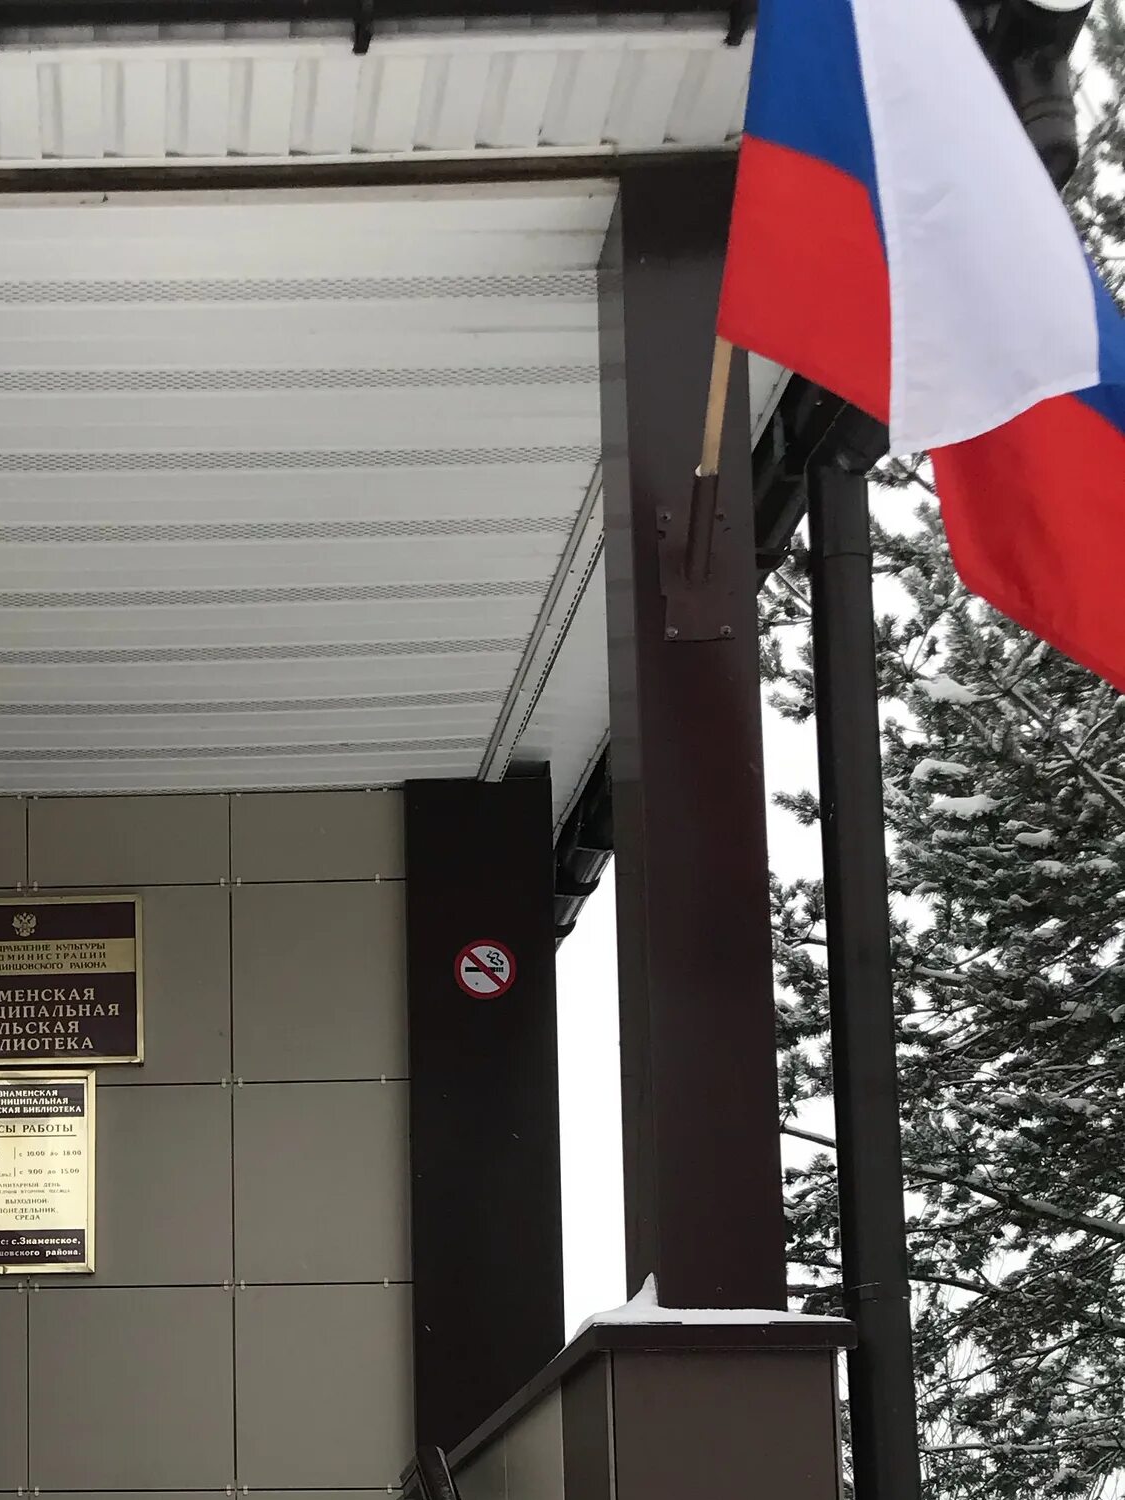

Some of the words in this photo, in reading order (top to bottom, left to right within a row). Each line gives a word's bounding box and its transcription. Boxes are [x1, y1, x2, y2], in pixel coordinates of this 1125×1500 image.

[55, 942, 106, 951] КУЛЬТУРЫ
[22, 1105, 82, 1114] БИБЛИОТЕКА
[22, 1123, 74, 1133] РАБОТЫ
